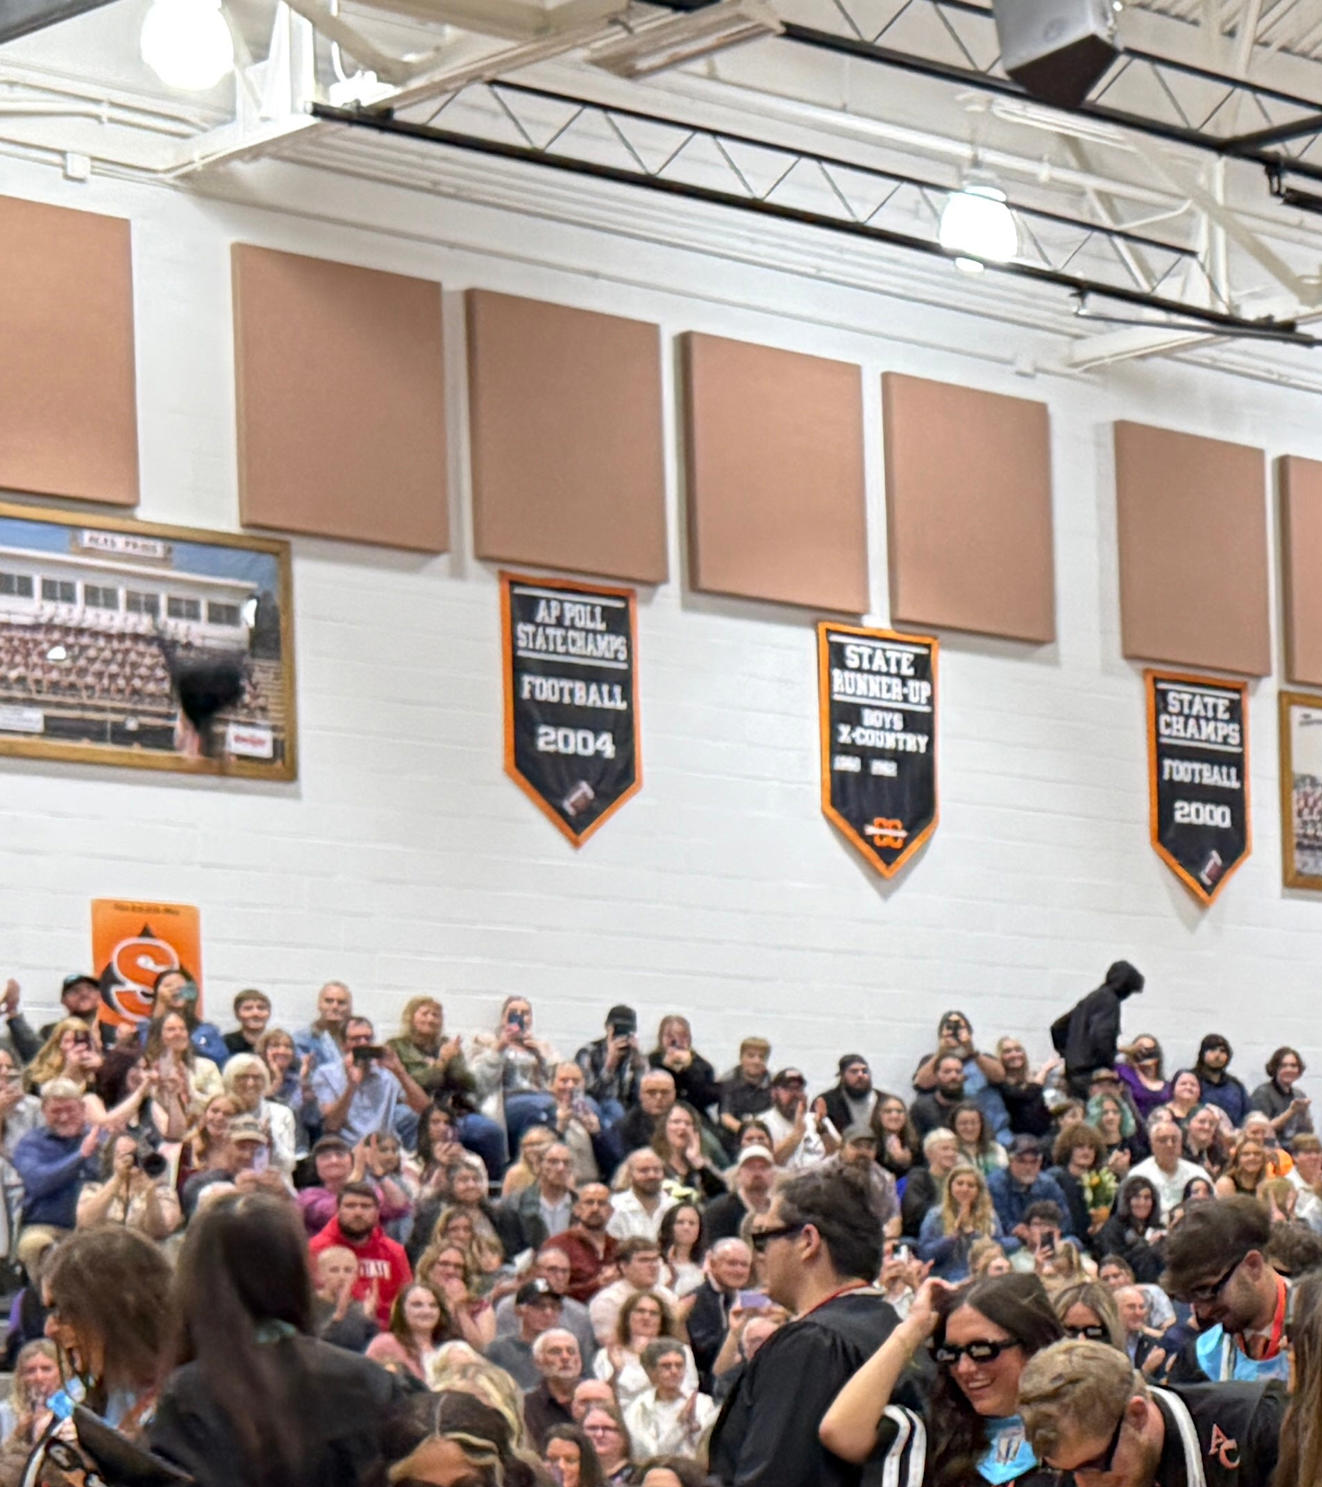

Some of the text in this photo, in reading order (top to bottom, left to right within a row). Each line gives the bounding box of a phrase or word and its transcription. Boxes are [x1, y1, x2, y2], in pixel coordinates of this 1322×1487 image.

[535, 599, 606, 632] AP POLL
[516, 621, 628, 661] STATE CHAMPS
[845, 644, 915, 676] STATE
[521, 674, 628, 711] FOOTBALL
[832, 668, 932, 705] RUNNER-UP
[861, 708, 904, 731] BOYS
[1166, 691, 1231, 721] STATE
[537, 724, 616, 759] 2004
[837, 723, 929, 753] X-COUNTRY
[1159, 713, 1241, 746] CHAMPS
[1162, 758, 1241, 790] FOOTBALL
[1173, 799, 1232, 828] 2000
